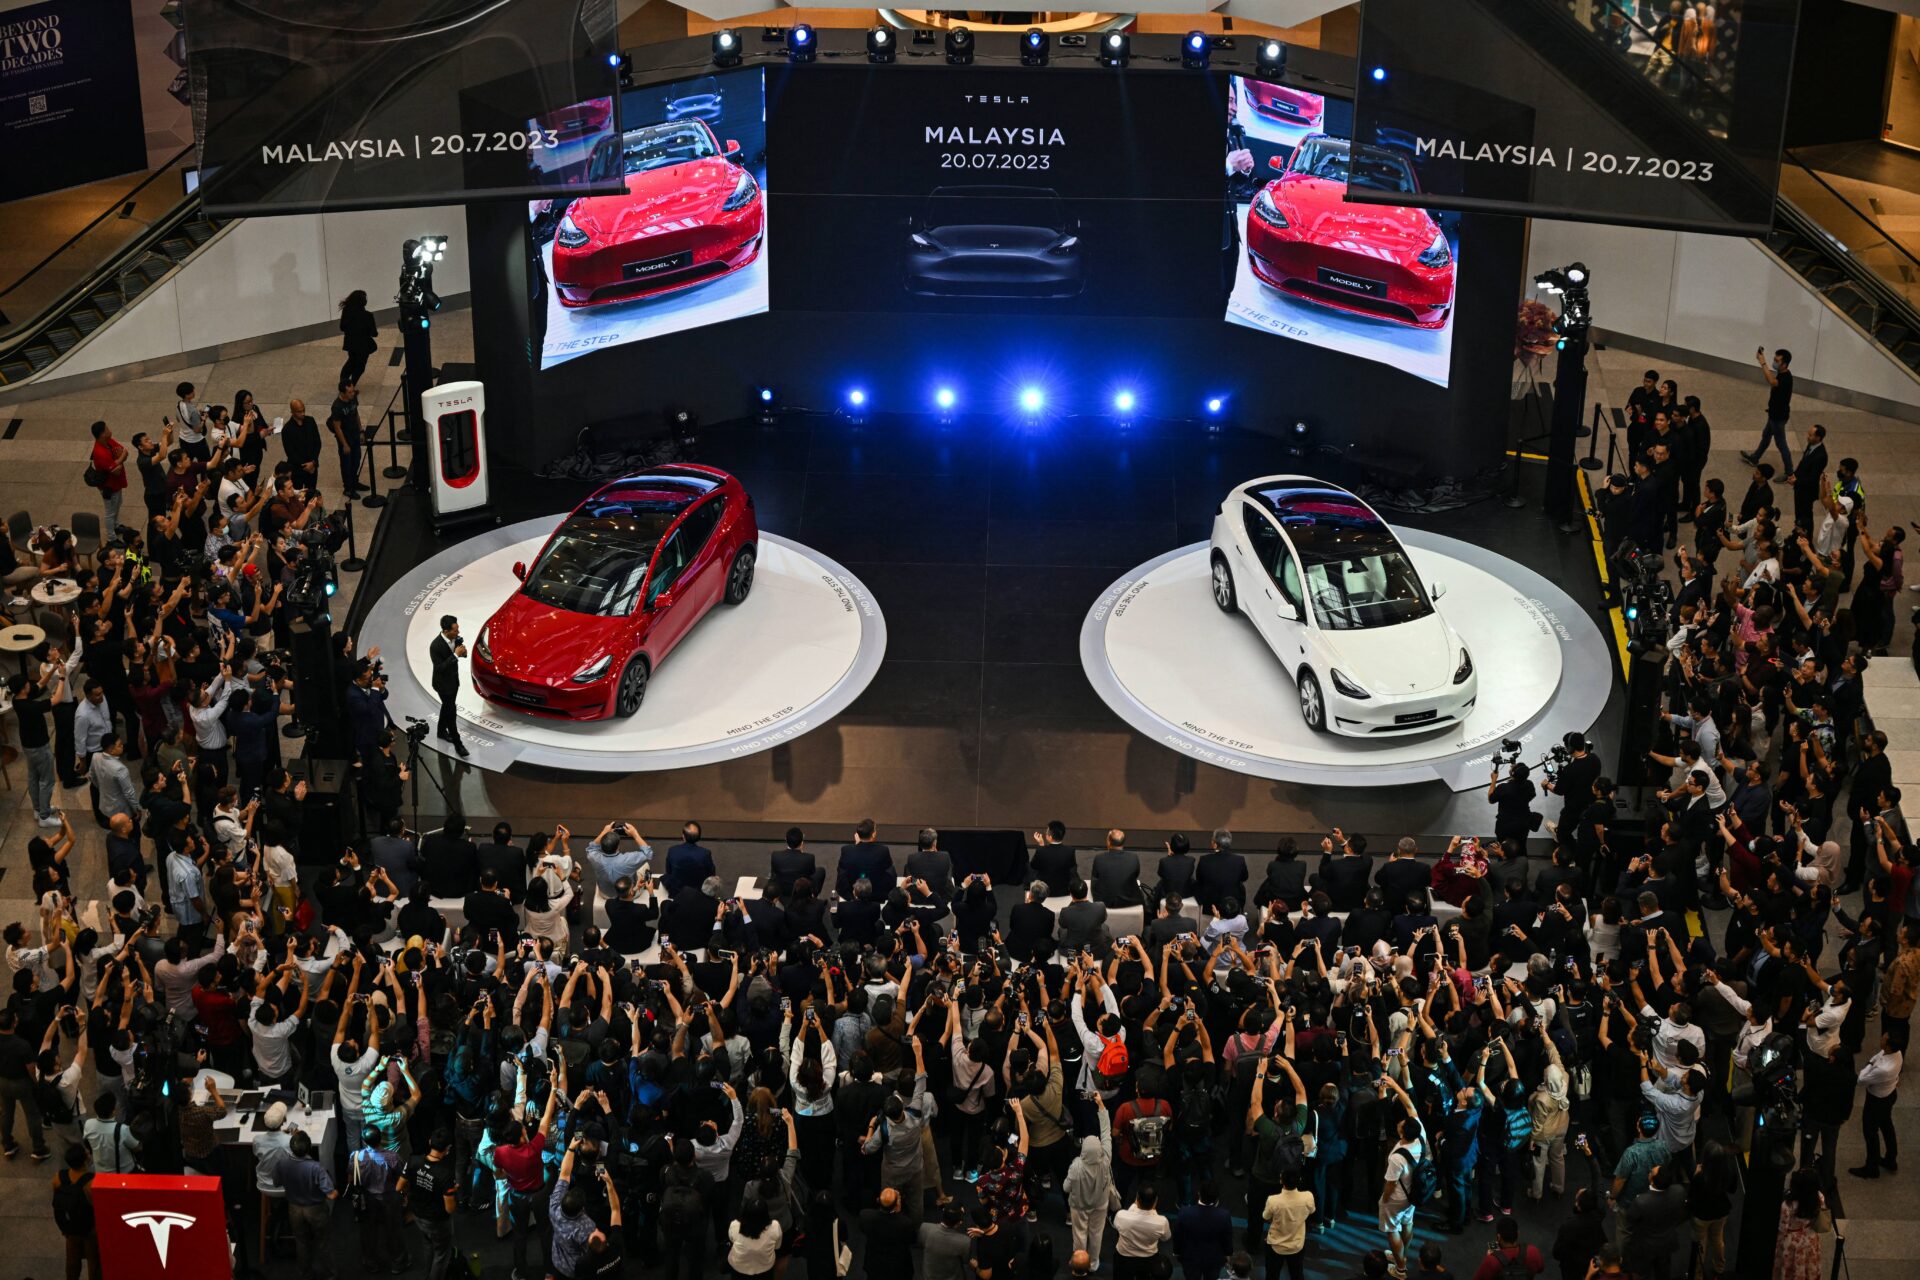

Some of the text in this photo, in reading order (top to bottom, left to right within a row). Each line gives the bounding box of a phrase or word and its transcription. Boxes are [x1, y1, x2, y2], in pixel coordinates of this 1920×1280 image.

[0, 15, 59, 39] BEYOND
[0, 28, 61, 58] TWO
[2, 48, 63, 71] DECADES
[965, 95, 1029, 103] TESLA
[261, 138, 405, 165] MALAYSIA
[430, 129, 559, 155] 20.7.2023
[925, 126, 1065, 146] MALAYSIA
[941, 153, 1050, 169] 20.07.2023
[1415, 137, 1556, 167] MALAYSIA
[1582, 151, 1714, 182] 20.7.2023
[635, 262, 670, 273] MODEL
[1329, 276, 1364, 289] MODEL
[1241, 307, 1309, 336] THE STEP
[555, 339, 581, 350] THE
[581, 334, 620, 347] STEP
[437, 396, 473, 407] TESLA
[480, 718, 503, 730] STEP
[726, 706, 793, 736] MIND THE STEP
[468, 735, 495, 748] STEP
[730, 720, 807, 754] MIND THE STEP
[1182, 721, 1254, 750] MIND THE STEP
[1165, 735, 1246, 767] MIND THE STEP
